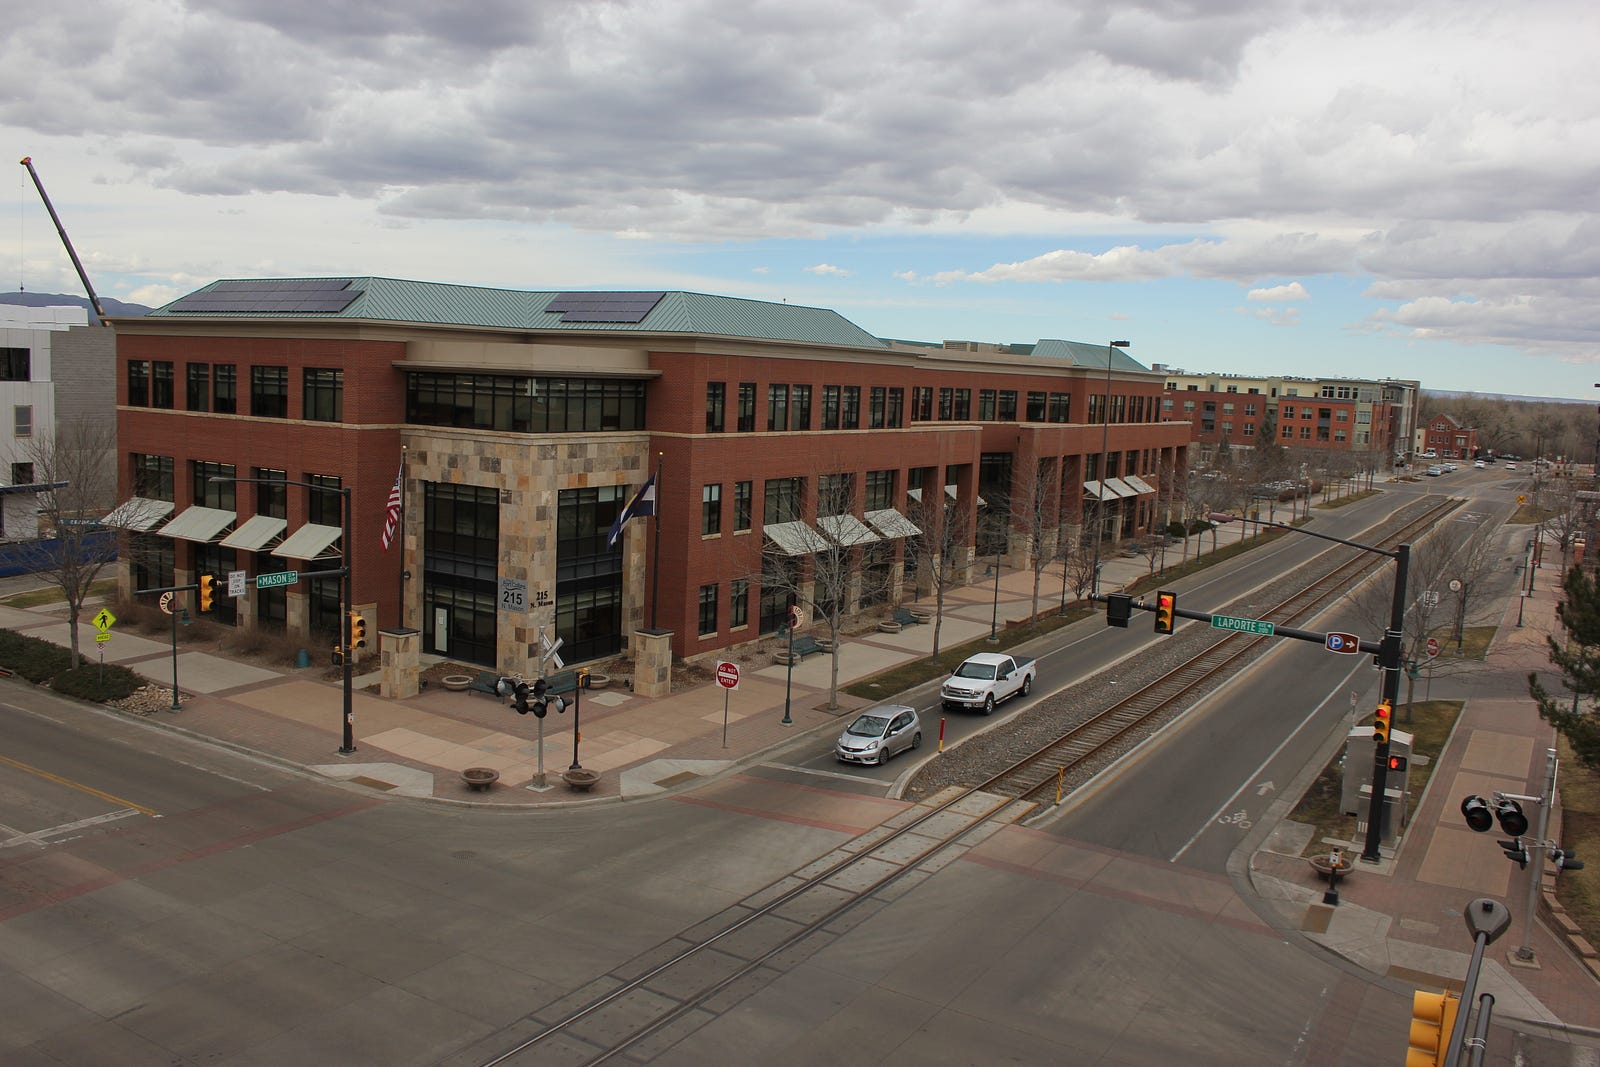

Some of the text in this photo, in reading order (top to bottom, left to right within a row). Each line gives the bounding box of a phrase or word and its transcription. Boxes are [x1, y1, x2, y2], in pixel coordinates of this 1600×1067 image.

[262, 574, 287, 586] MASON
[503, 591, 522, 605] 215
[536, 590, 548, 600] 215
[1218, 617, 1257, 631] LAPORTE
[1331, 636, 1341, 648] P
[720, 677, 734, 685] ENTER
